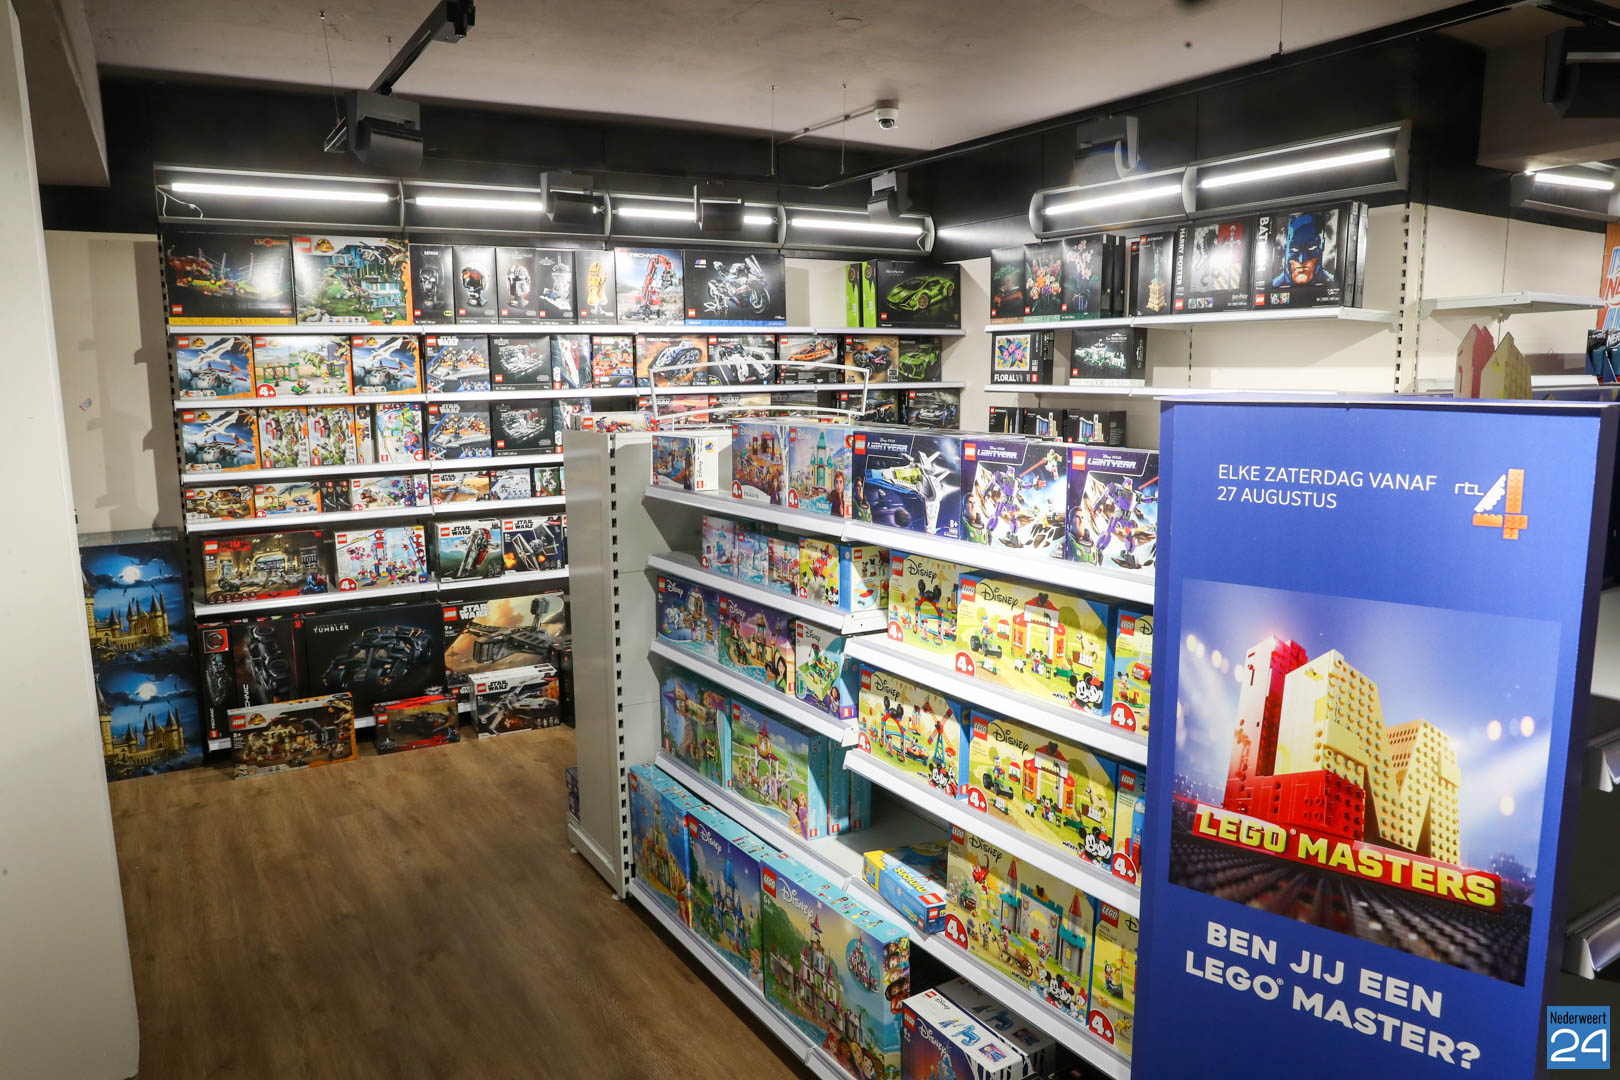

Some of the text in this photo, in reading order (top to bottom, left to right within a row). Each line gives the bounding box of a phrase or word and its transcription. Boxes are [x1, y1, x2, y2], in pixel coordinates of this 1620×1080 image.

[1176, 227, 1186, 286] HARRY POTTER
[994, 373, 1017, 382] FLORAL
[1087, 458, 1137, 470] LIGHTYEAR
[1217, 463, 1438, 492] ELKE ZATERDAG VANAF
[1216, 485, 1337, 510] 27 AUGUSTUS
[905, 558, 938, 584] Disney
[462, 603, 489, 613] STAR
[980, 582, 1019, 611] Disney
[459, 609, 489, 620] WARS
[313, 625, 350, 634] TUMBLER
[956, 656, 974, 673] 4+
[873, 673, 900, 702] Disney
[1113, 707, 1134, 727] 4+
[991, 722, 1029, 754] Disney
[969, 791, 986, 809] 4+
[1114, 858, 1135, 877] 4+
[1199, 808, 1497, 908] LEGO MASTERS
[778, 877, 814, 924] Disney
[946, 919, 967, 943] 4+
[1207, 920, 1443, 1019] BEN JIJ EEN
[1185, 950, 1482, 1071] LEGO MASTER?
[917, 1017, 947, 1057] Disney
[1091, 1014, 1113, 1039] 4+
